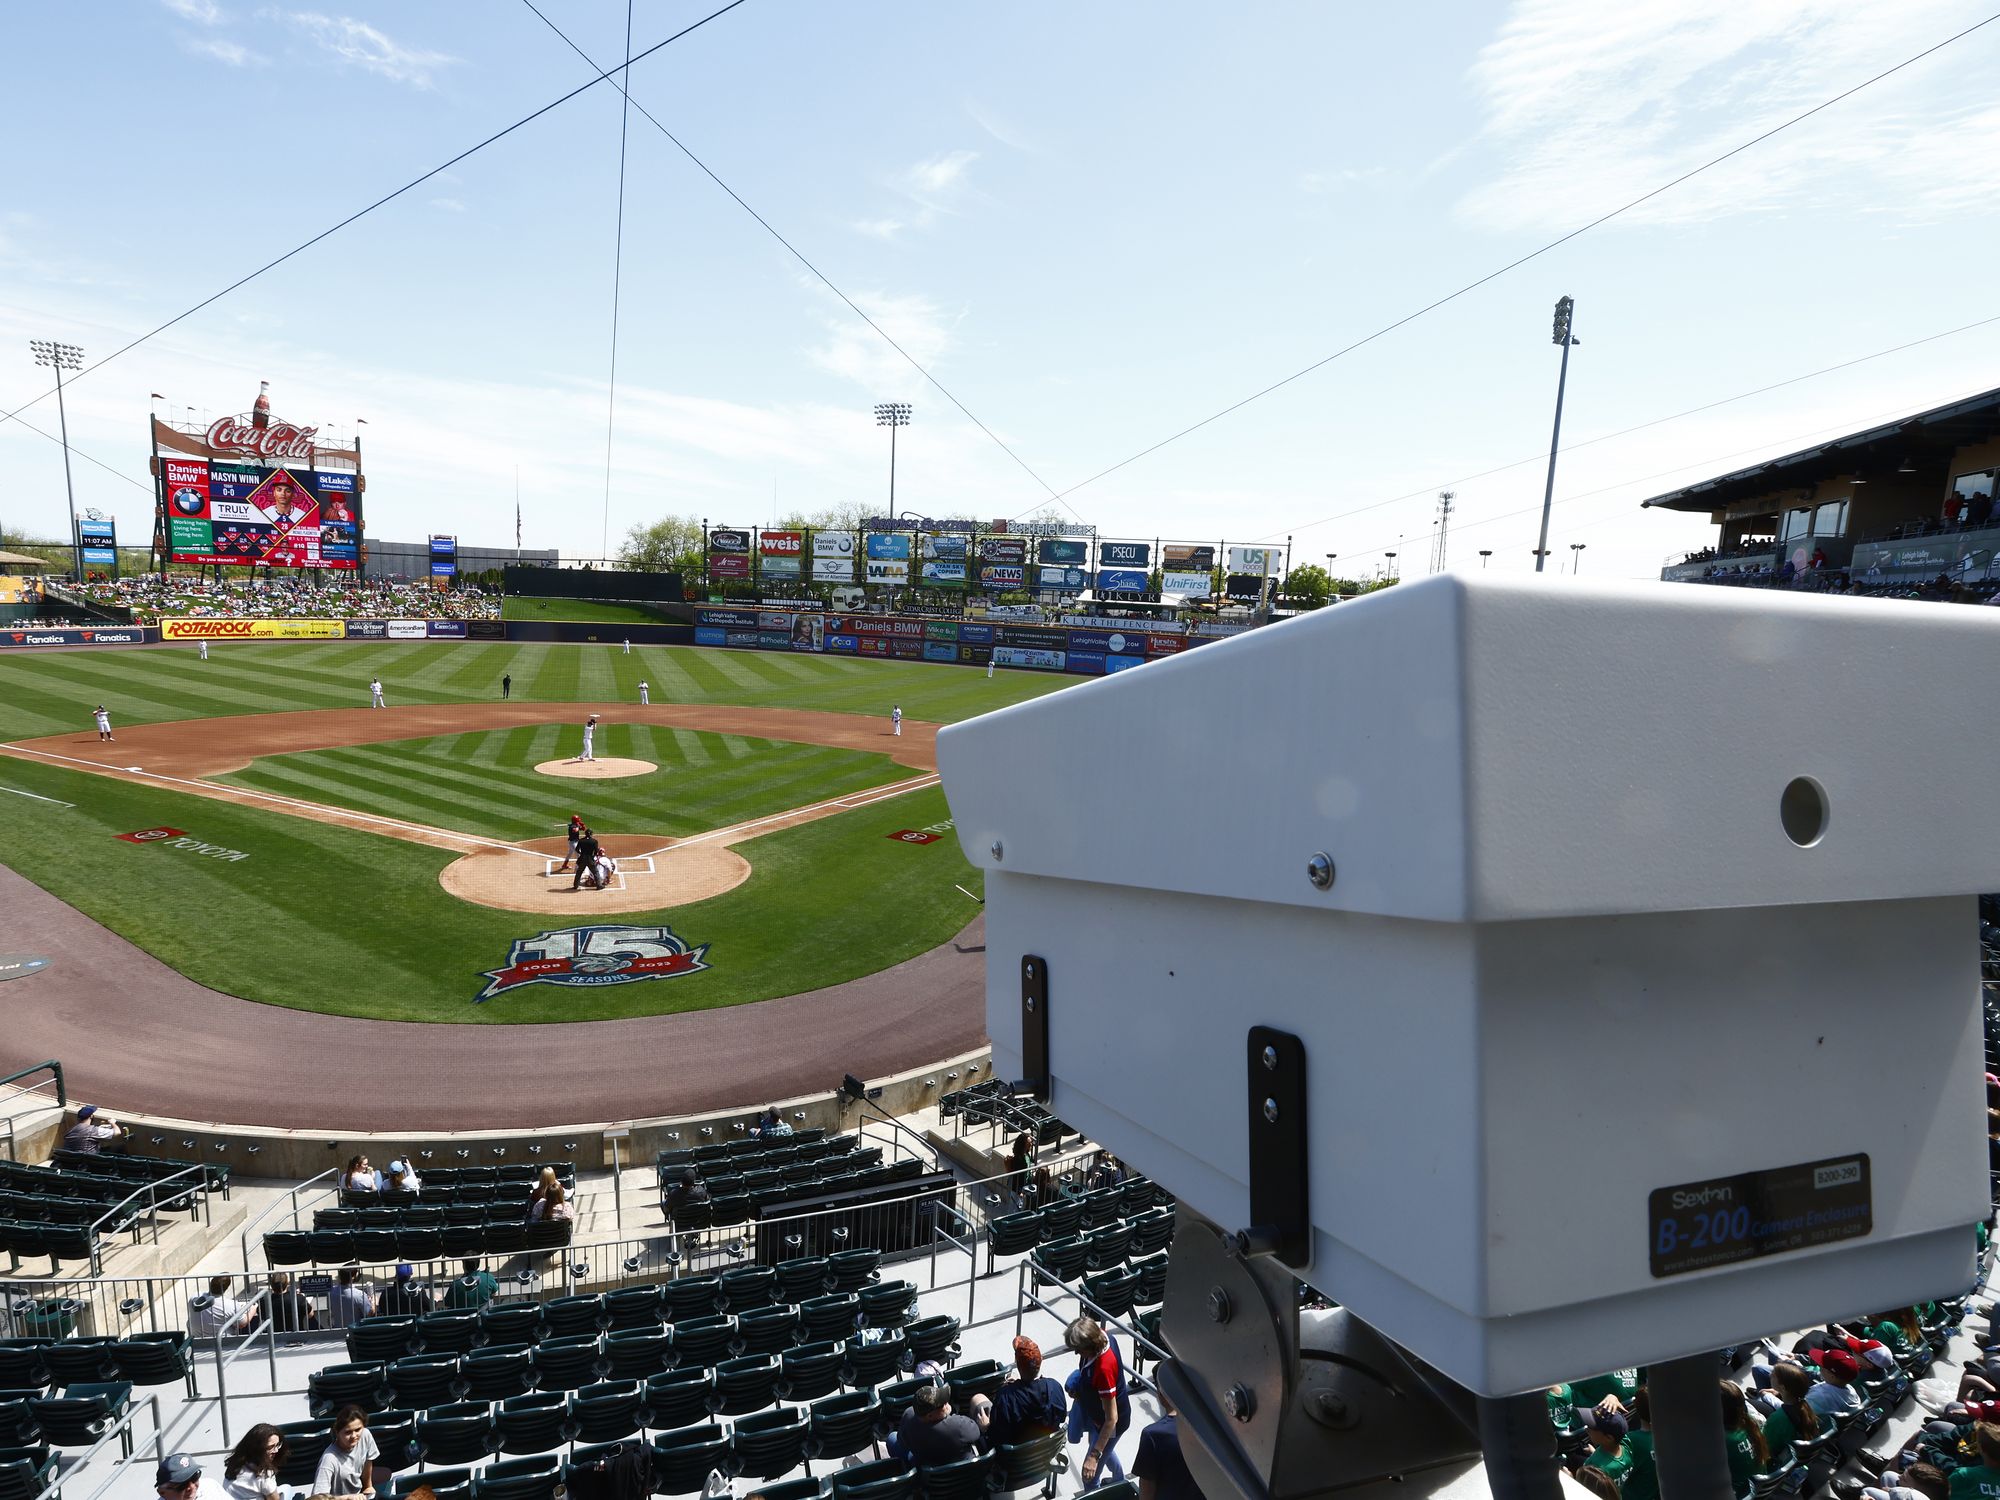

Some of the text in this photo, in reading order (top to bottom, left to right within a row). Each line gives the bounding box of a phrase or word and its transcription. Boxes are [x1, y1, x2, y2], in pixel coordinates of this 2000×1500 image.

[168, 463, 208, 475] Daniels
[241, 457, 287, 469] PARK
[168, 472, 197, 482] BMW
[211, 472, 260, 484] MASYN WINN
[223, 488, 235, 496] 0-0
[218, 504, 249, 514] TRULY
[762, 536, 800, 551] weis
[1112, 546, 1136, 559] PSECU
[869, 566, 903, 578] WM
[994, 569, 1021, 579] NEWS
[1165, 577, 1209, 590] UniFirst
[855, 620, 921, 634] Daniels BMW
[1101, 619, 1118, 627] THE
[1123, 620, 1155, 629] FENCE
[95, 633, 131, 642] Fanatics
[282, 629, 300, 637] Jeep
[26, 635, 64, 644] Fanatics
[766, 637, 788, 645] Phoebe
[164, 837, 250, 862] TOYOTA
[520, 927, 677, 960] 15
[522, 963, 561, 972] 2008
[568, 973, 631, 984] SEASONS
[1817, 1167, 1857, 1184] B200-290
[1672, 1187, 1732, 1210] Sexton
[1657, 1201, 1868, 1256] B-200 Camera Enclosure
